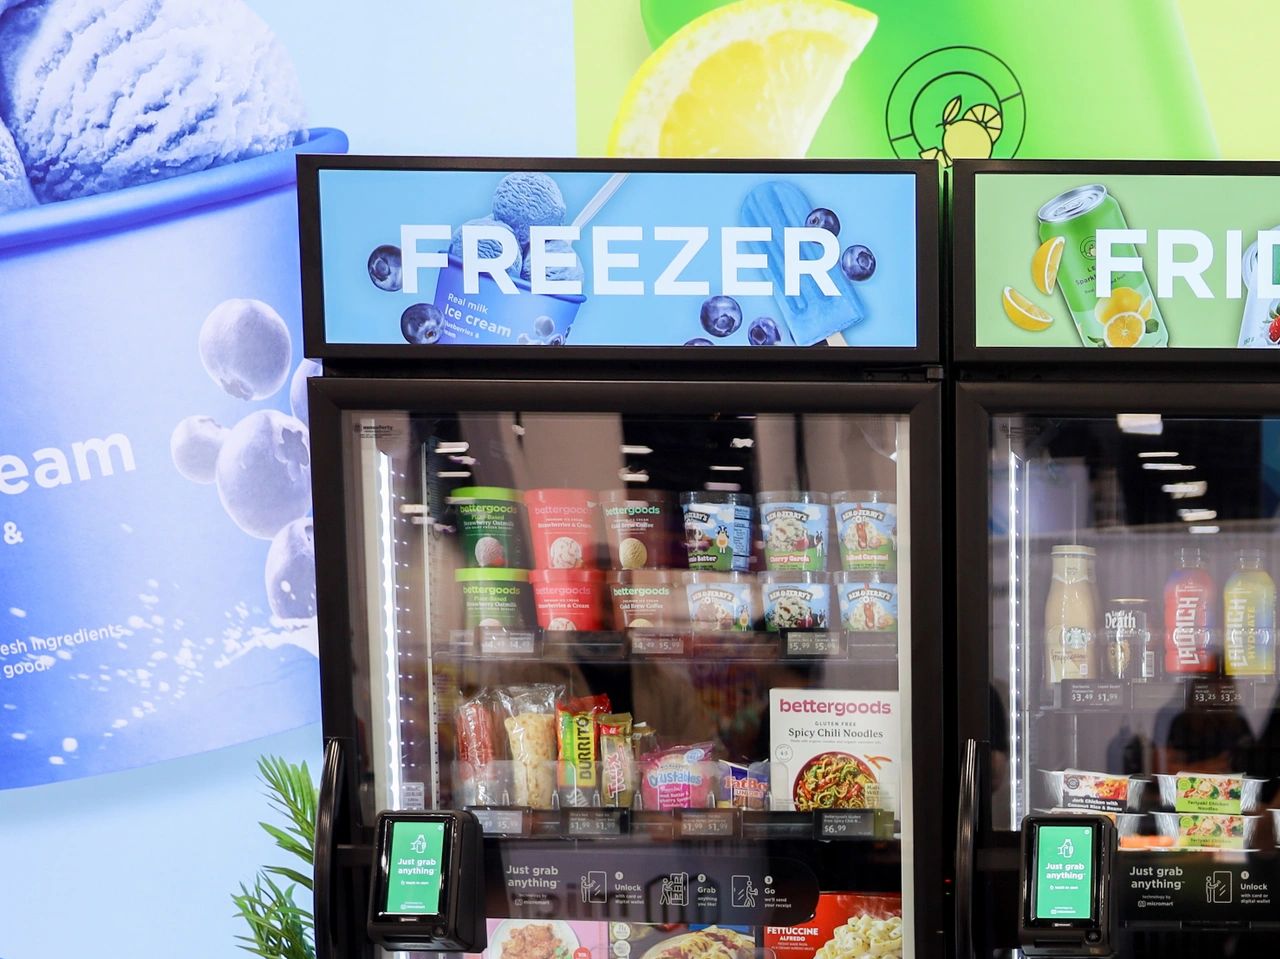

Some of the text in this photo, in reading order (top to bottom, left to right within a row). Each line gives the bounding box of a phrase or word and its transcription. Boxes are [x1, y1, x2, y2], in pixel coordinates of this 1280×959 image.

[400, 224, 842, 297] FREEZER
[448, 293, 488, 314] Real milk
[445, 303, 512, 338] Ice cream
[3, 522, 24, 545] &
[1105, 611, 1137, 629] Death
[779, 697, 892, 717] bettergoods
[788, 727, 884, 739] Spicy Chili Noodles
[579, 713, 593, 781] BURRITO
[824, 824, 847, 835] $6.99
[506, 865, 558, 877] Just grab
[1065, 863, 1085, 871] grab
[1129, 866, 1183, 878] Just grab
[1240, 883, 1267, 891] Unlock
[766, 925, 819, 936] FETTUCCINE
